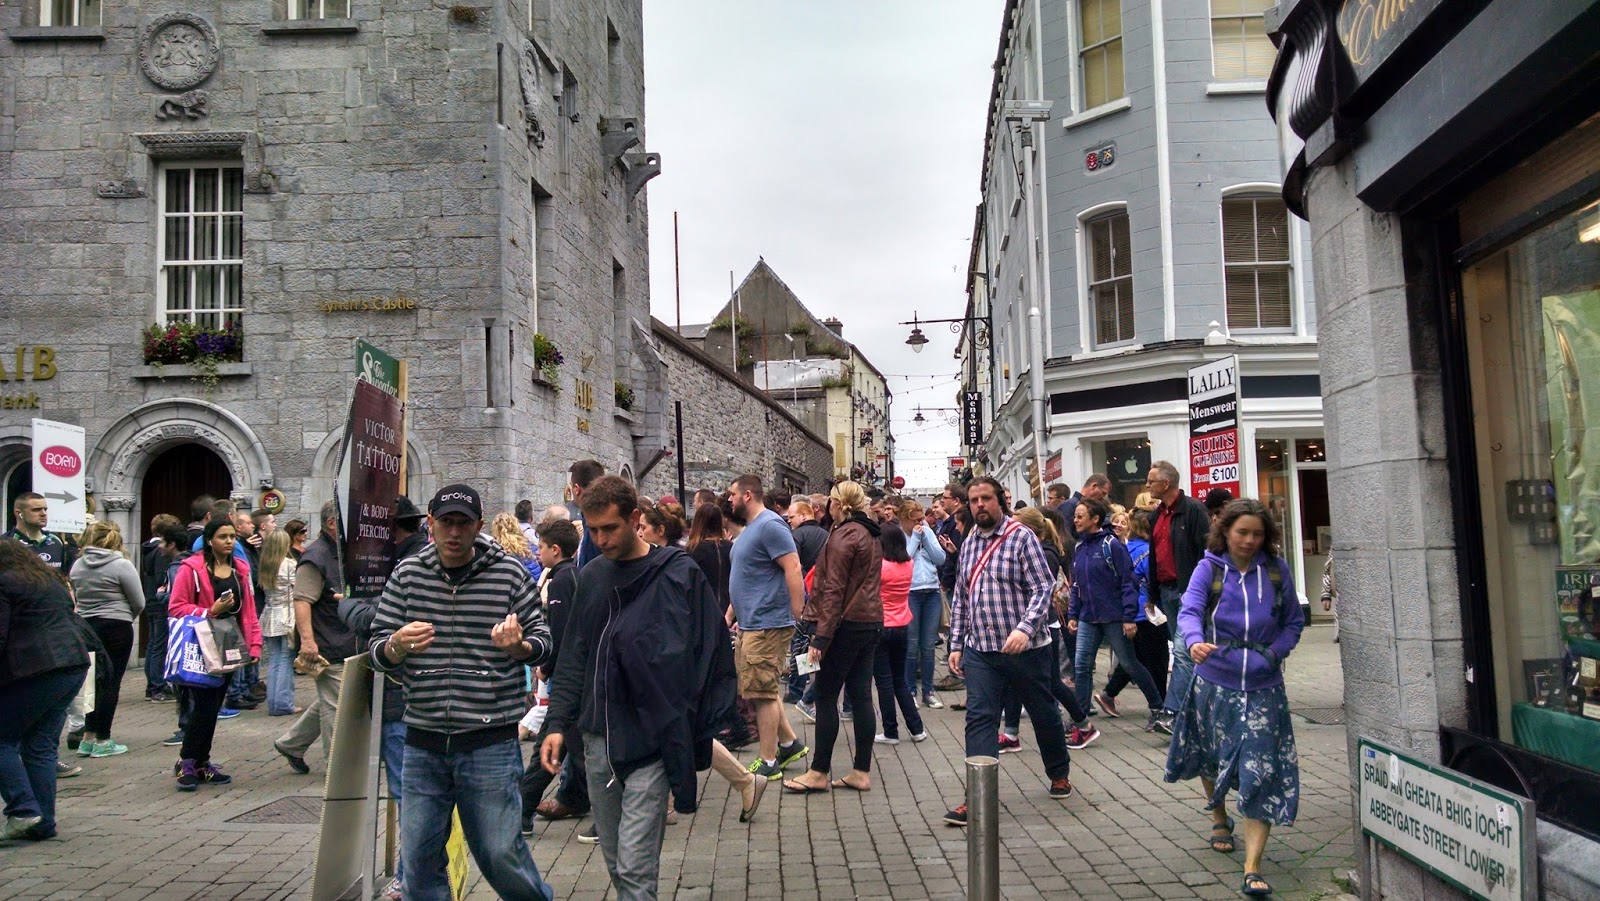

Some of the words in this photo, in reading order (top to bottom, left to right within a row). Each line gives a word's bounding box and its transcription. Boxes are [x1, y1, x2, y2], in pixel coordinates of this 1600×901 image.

[372, 296, 414, 310] Castle
[1190, 367, 1234, 395] LALLY
[0, 391, 39, 409] ank
[967, 392, 979, 444] Menswear
[1190, 400, 1236, 420] Menswear
[365, 418, 395, 444] VICTOR
[1192, 432, 1235, 455] SUITS
[46, 453, 77, 468] BORN
[357, 440, 398, 474] TATTOO
[1193, 449, 1235, 468] CLEARING
[1212, 467, 1237, 481] €100
[371, 505, 389, 519] BODY
[359, 524, 390, 539] PIERCING
[185, 641, 199, 652] LIFE
[184, 651, 204, 662] STYLE
[1405, 781, 1443, 816] GHEATA
[1446, 798, 1472, 830] BHIG
[1475, 805, 1512, 848] ÍOCHT
[1370, 797, 1420, 841] ABBEYGATE
[1423, 824, 1461, 862] STREET
[1464, 845, 1505, 887] LOWER
